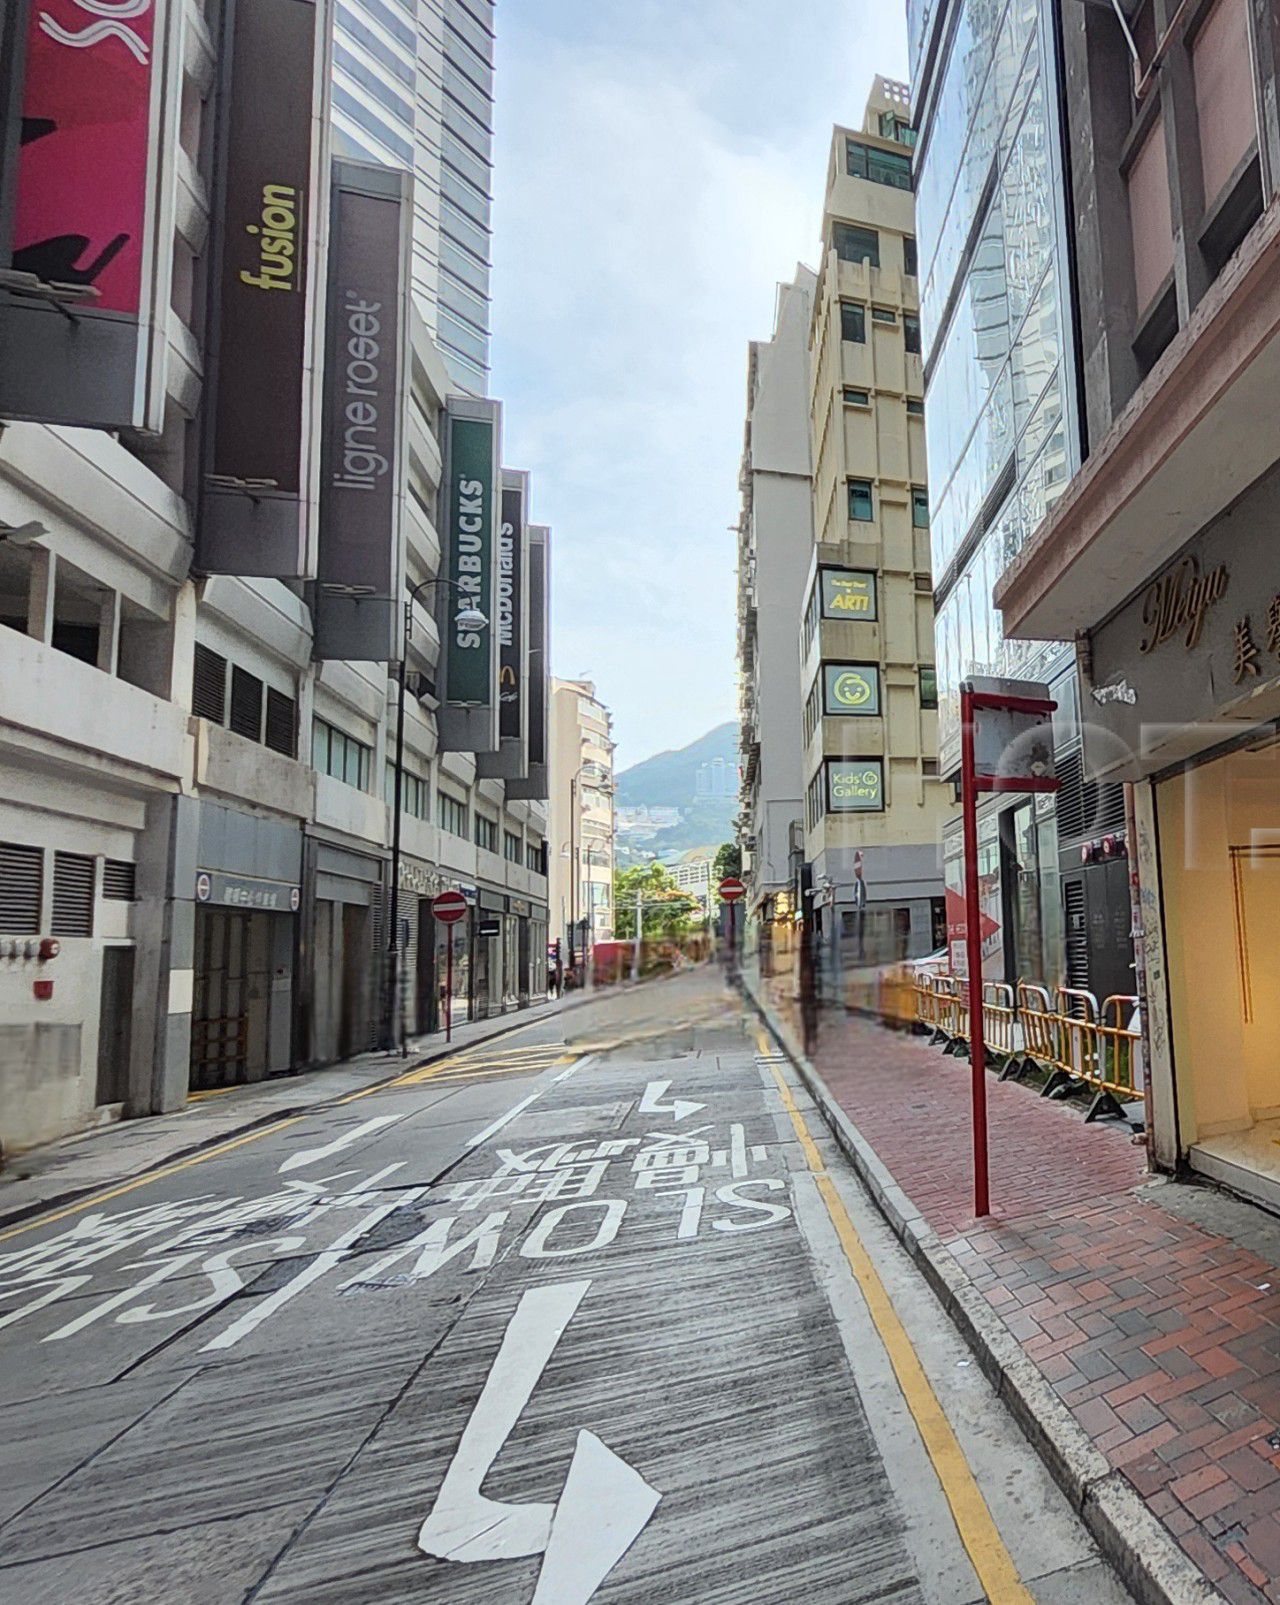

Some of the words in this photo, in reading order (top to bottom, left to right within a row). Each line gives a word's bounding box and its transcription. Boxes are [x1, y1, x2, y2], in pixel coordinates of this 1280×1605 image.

[240, 184, 297, 292] fusion
[345, 299, 382, 396] roset
[333, 401, 389, 489] ligne
[833, 785, 878, 799] Gallery
[446, 1123, 768, 1212] 慢駛
[337, 1178, 793, 1294] SLOW
